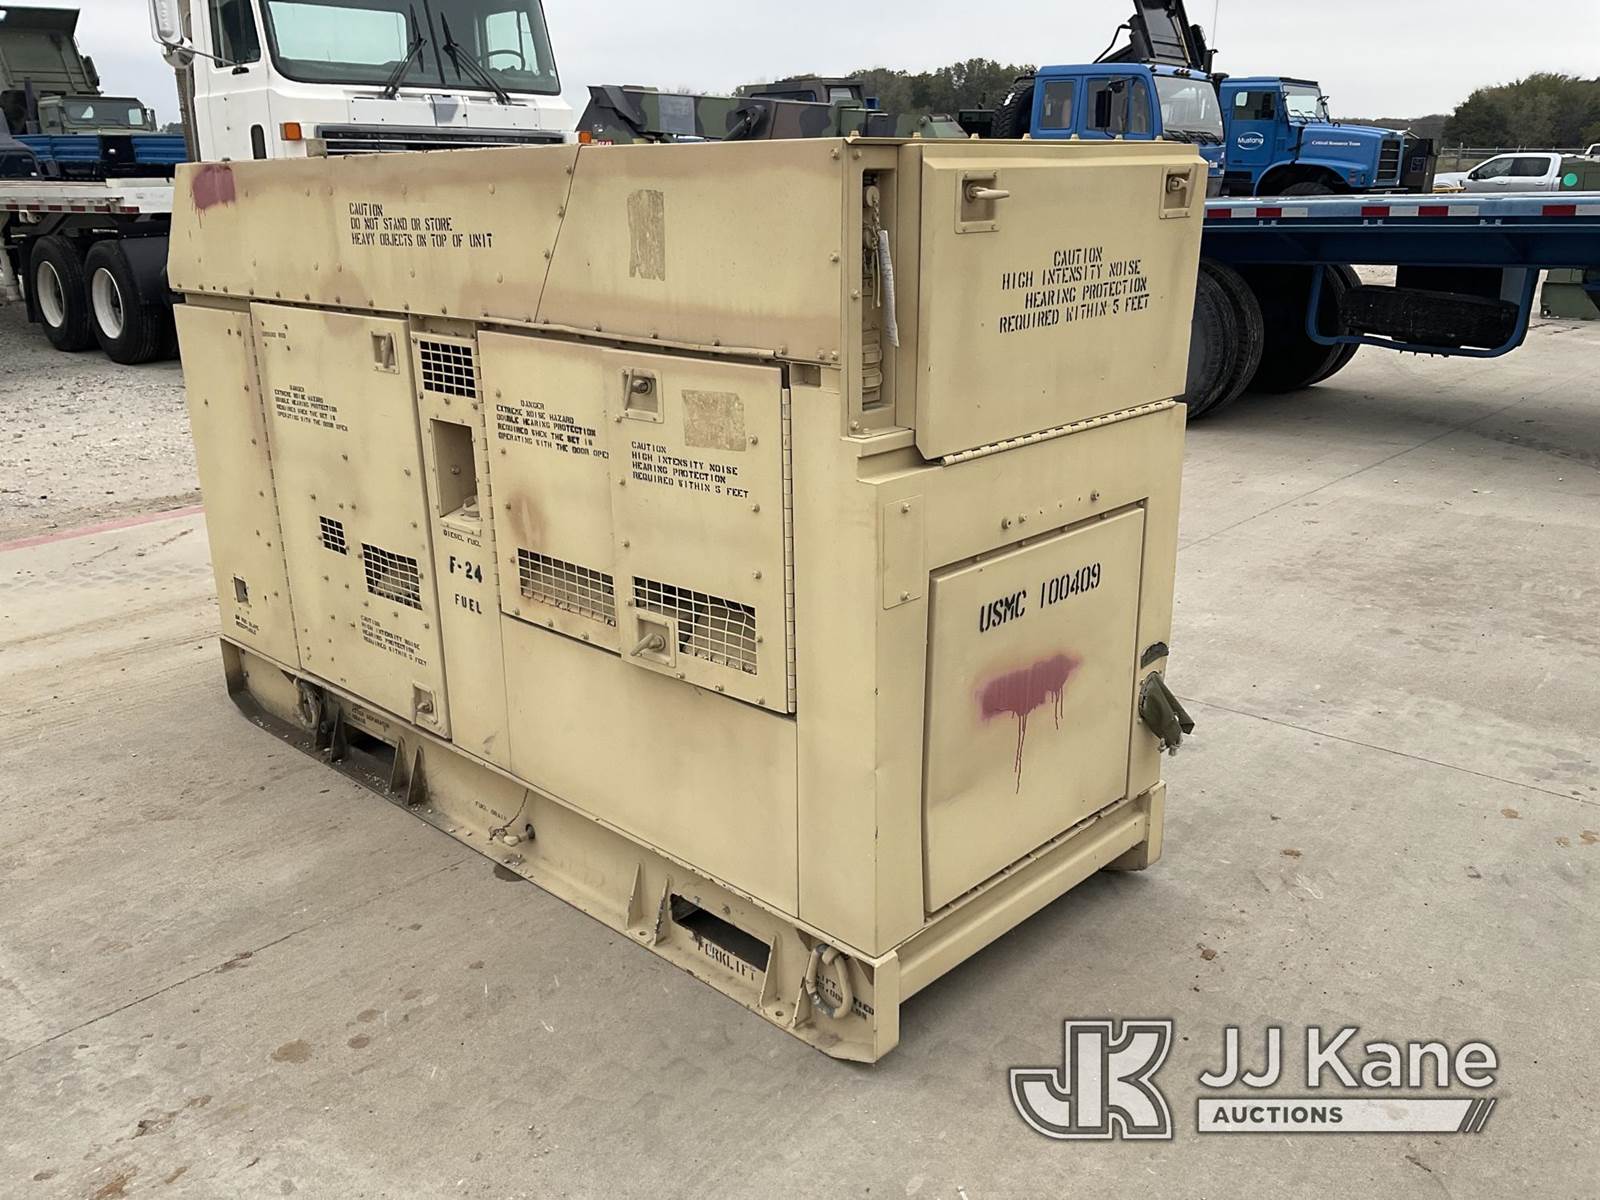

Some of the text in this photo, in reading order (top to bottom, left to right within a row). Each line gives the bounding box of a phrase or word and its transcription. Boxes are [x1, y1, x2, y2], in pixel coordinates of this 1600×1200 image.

[1237, 137, 1264, 145] Mustang
[349, 202, 383, 216] CAUTION
[350, 217, 453, 231] DO NOT STAND OR STORE
[352, 232, 492, 248] HEAVY OBJECTS ON TOP OF UNIT
[1054, 246, 1103, 267] CAUTION
[1002, 260, 1142, 290] HIGH INTENSITY NOISE
[1025, 277, 1148, 309] HEARING PROTECTION
[1000, 294, 1150, 333] REQUIRED WITHIN 5 FEET
[496, 404, 575, 425] EXTREME NOISE HAZARD
[520, 400, 545, 410] DANGER
[496, 414, 597, 437] DOUBLE HEARING PROTECTION
[498, 423, 529, 435] REQUIRED
[532, 429, 548, 439] WHEN
[551, 432, 564, 442] THE
[566, 434, 580, 445] SET
[498, 432, 533, 445] OPERATING
[536, 440, 552, 449] WITH
[556, 442, 568, 453] THE
[572, 446, 590, 456] DOOR
[632, 440, 667, 454] CAUTION
[632, 451, 738, 476] HIGH INTENSITY NOISE
[632, 461, 726, 484] HEARING PROTECTION
[633, 471, 749, 498] REQUIRED WITHIN 5 FEET
[443, 529, 482, 548] DIESEL FUEL
[450, 556, 482, 583] F-24
[455, 593, 482, 615] FUEL
[979, 563, 1100, 632] USMC 100409
[698, 938, 756, 981] FORKLIFT
